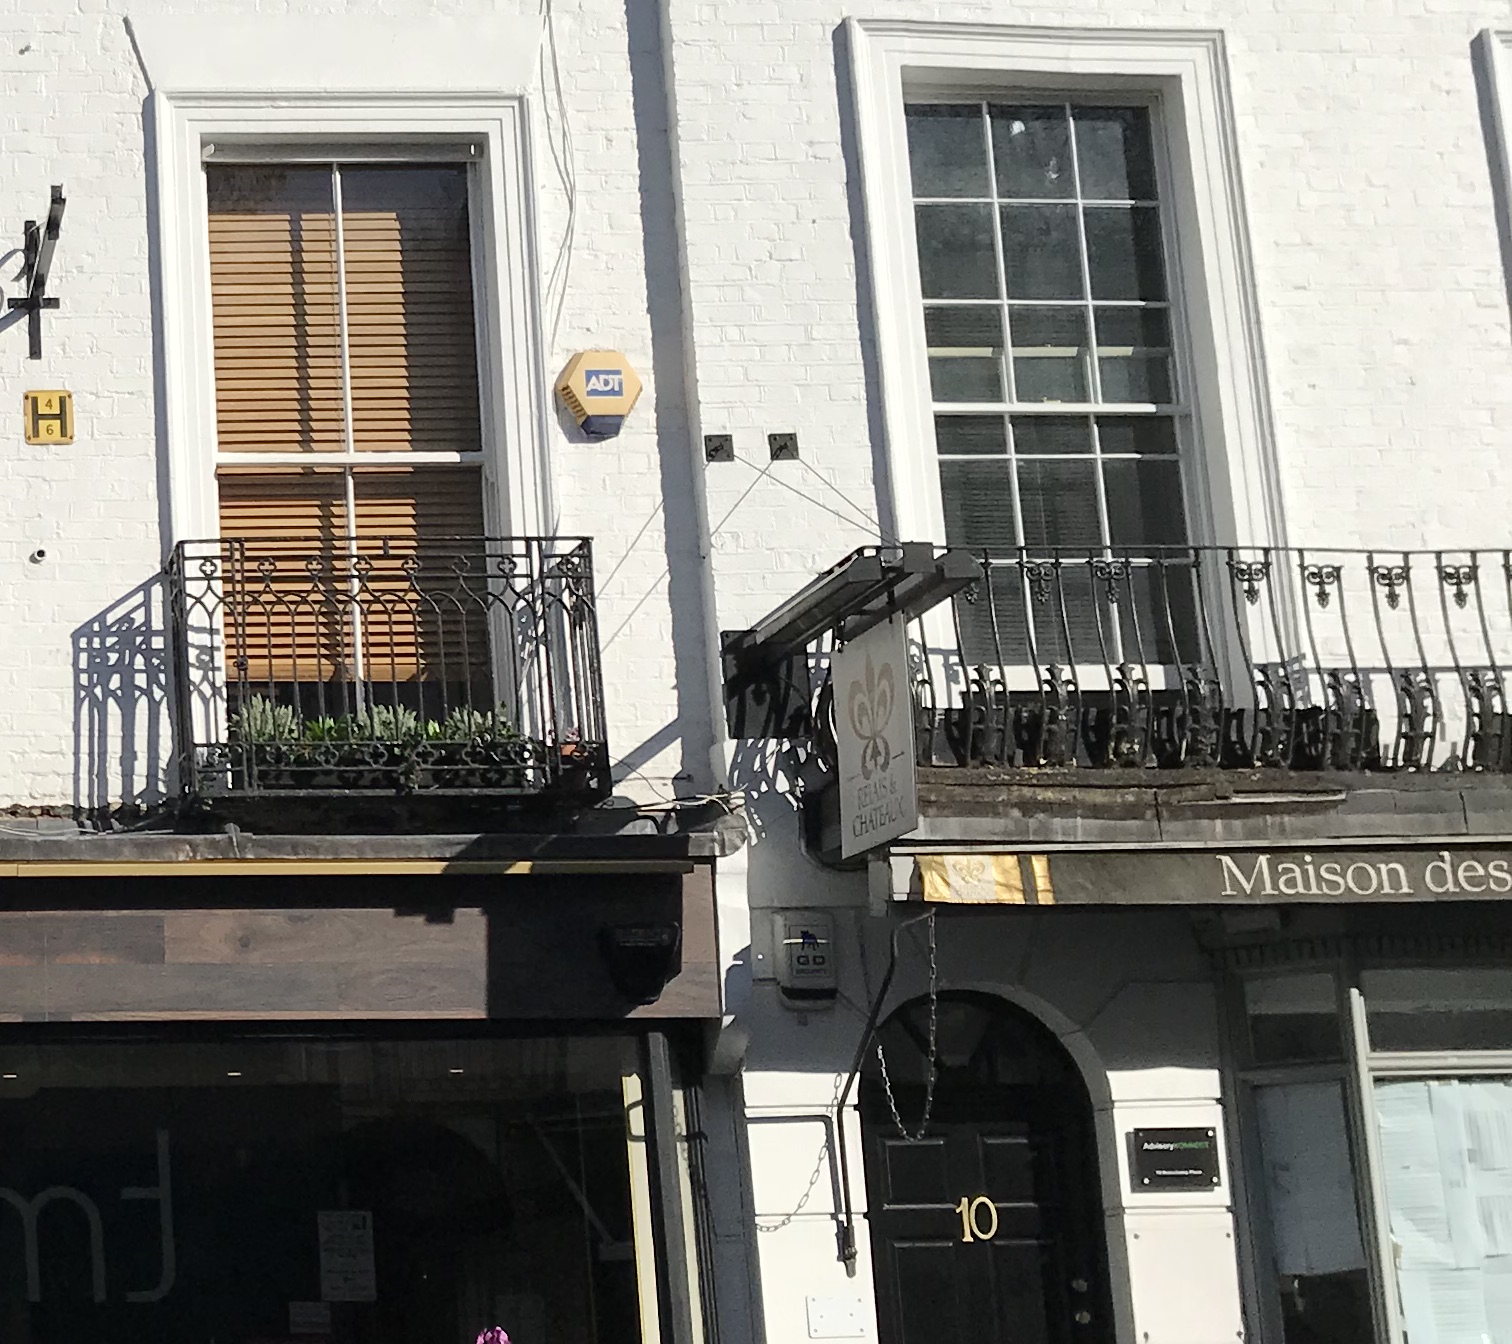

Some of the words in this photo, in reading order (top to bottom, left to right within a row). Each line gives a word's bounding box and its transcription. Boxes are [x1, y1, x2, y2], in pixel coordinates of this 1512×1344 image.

[587, 374, 622, 392] ADT
[31, 396, 68, 438] H
[45, 398, 54, 410] 4
[46, 424, 54, 436] 6
[1215, 853, 1415, 896] Maison
[1424, 850, 1512, 894] des
[955, 1196, 998, 1243] 10
